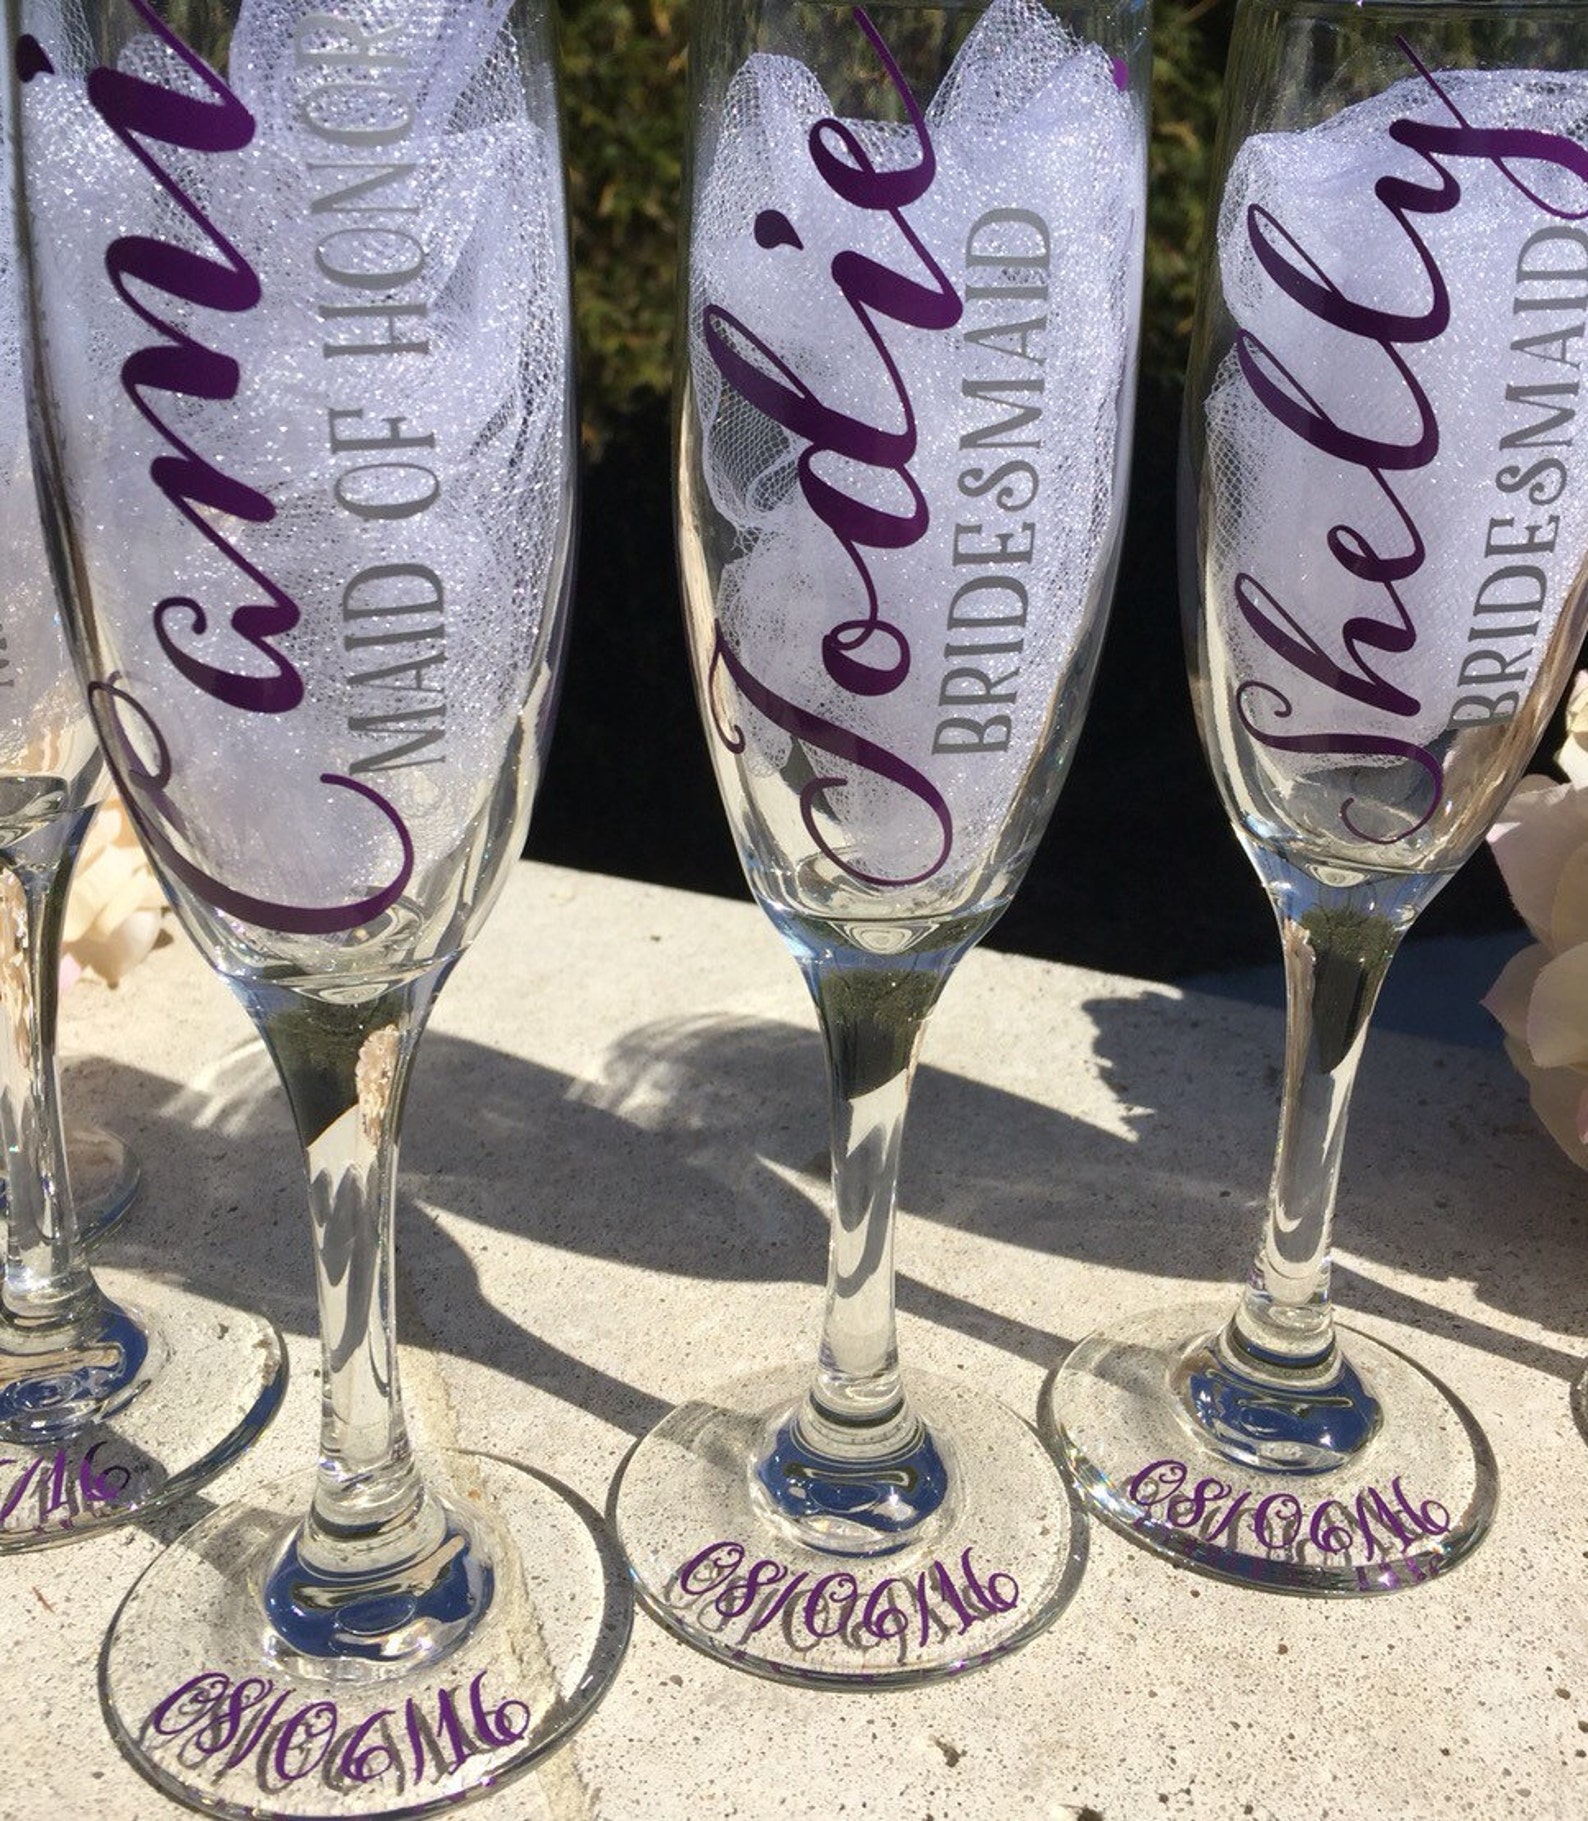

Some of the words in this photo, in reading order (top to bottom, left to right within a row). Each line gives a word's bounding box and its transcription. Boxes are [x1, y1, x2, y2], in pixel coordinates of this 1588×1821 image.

[302, 13, 430, 359] HONOR
[703, 6, 964, 887] Jodie
[1235, 34, 1588, 845] Shelly
[15, 0, 414, 934] Cami
[328, 407, 440, 522] OF
[343, 562, 447, 775] MAID
[931, 206, 1051, 756] BRIDESMAID
[1446, 225, 1588, 731] BRIDESMAID
